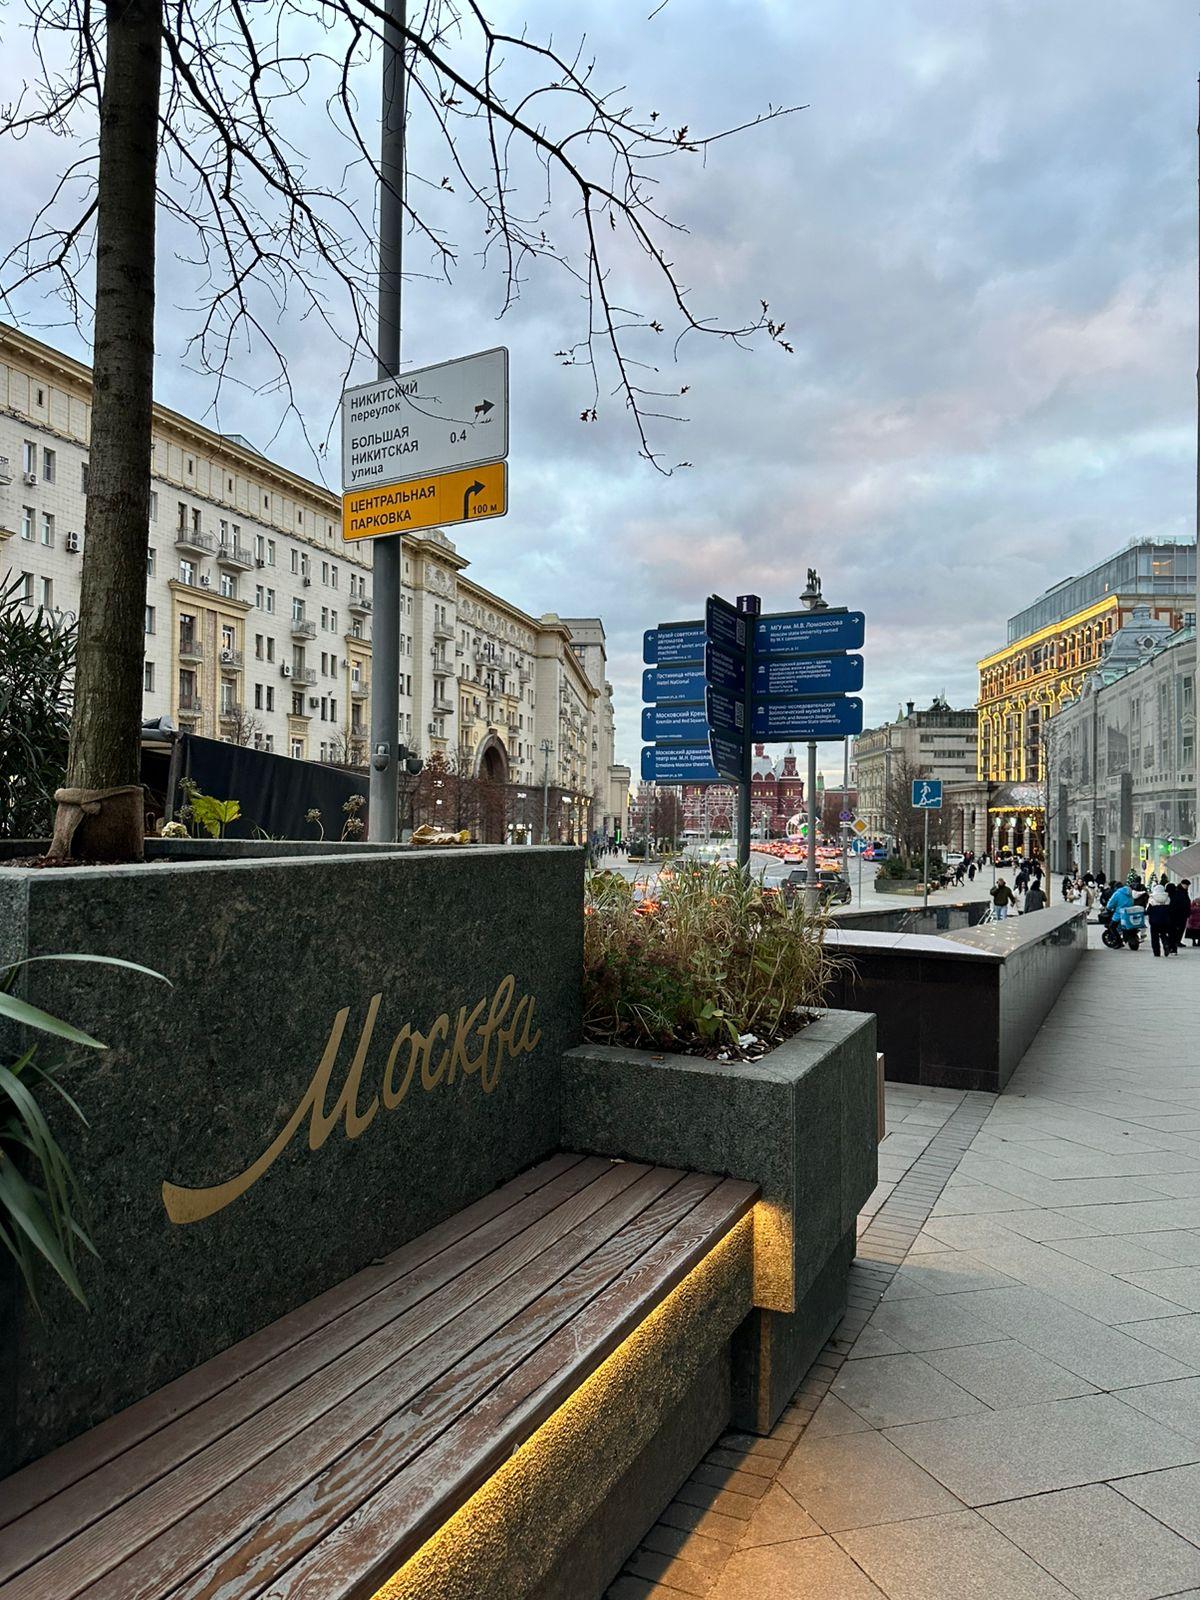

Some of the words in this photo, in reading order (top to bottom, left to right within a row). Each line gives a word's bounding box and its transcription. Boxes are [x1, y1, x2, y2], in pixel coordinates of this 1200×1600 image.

[351, 380, 418, 409] НИКИТСКИЙ
[351, 402, 401, 423] переулок
[352, 426, 410, 449] БОЛЬШАЯ
[450, 429, 467, 444] 0.4
[352, 440, 419, 465] НИКИТСКАЯ
[352, 463, 384, 481] улица
[351, 485, 436, 513] ЦЕНТРАЛЬНАЯ
[472, 504, 488, 515] 100
[350, 509, 412, 531] ПАРКОВКА
[806, 620, 843, 628] Ломоносова
[161, 974, 542, 1225] Москва
